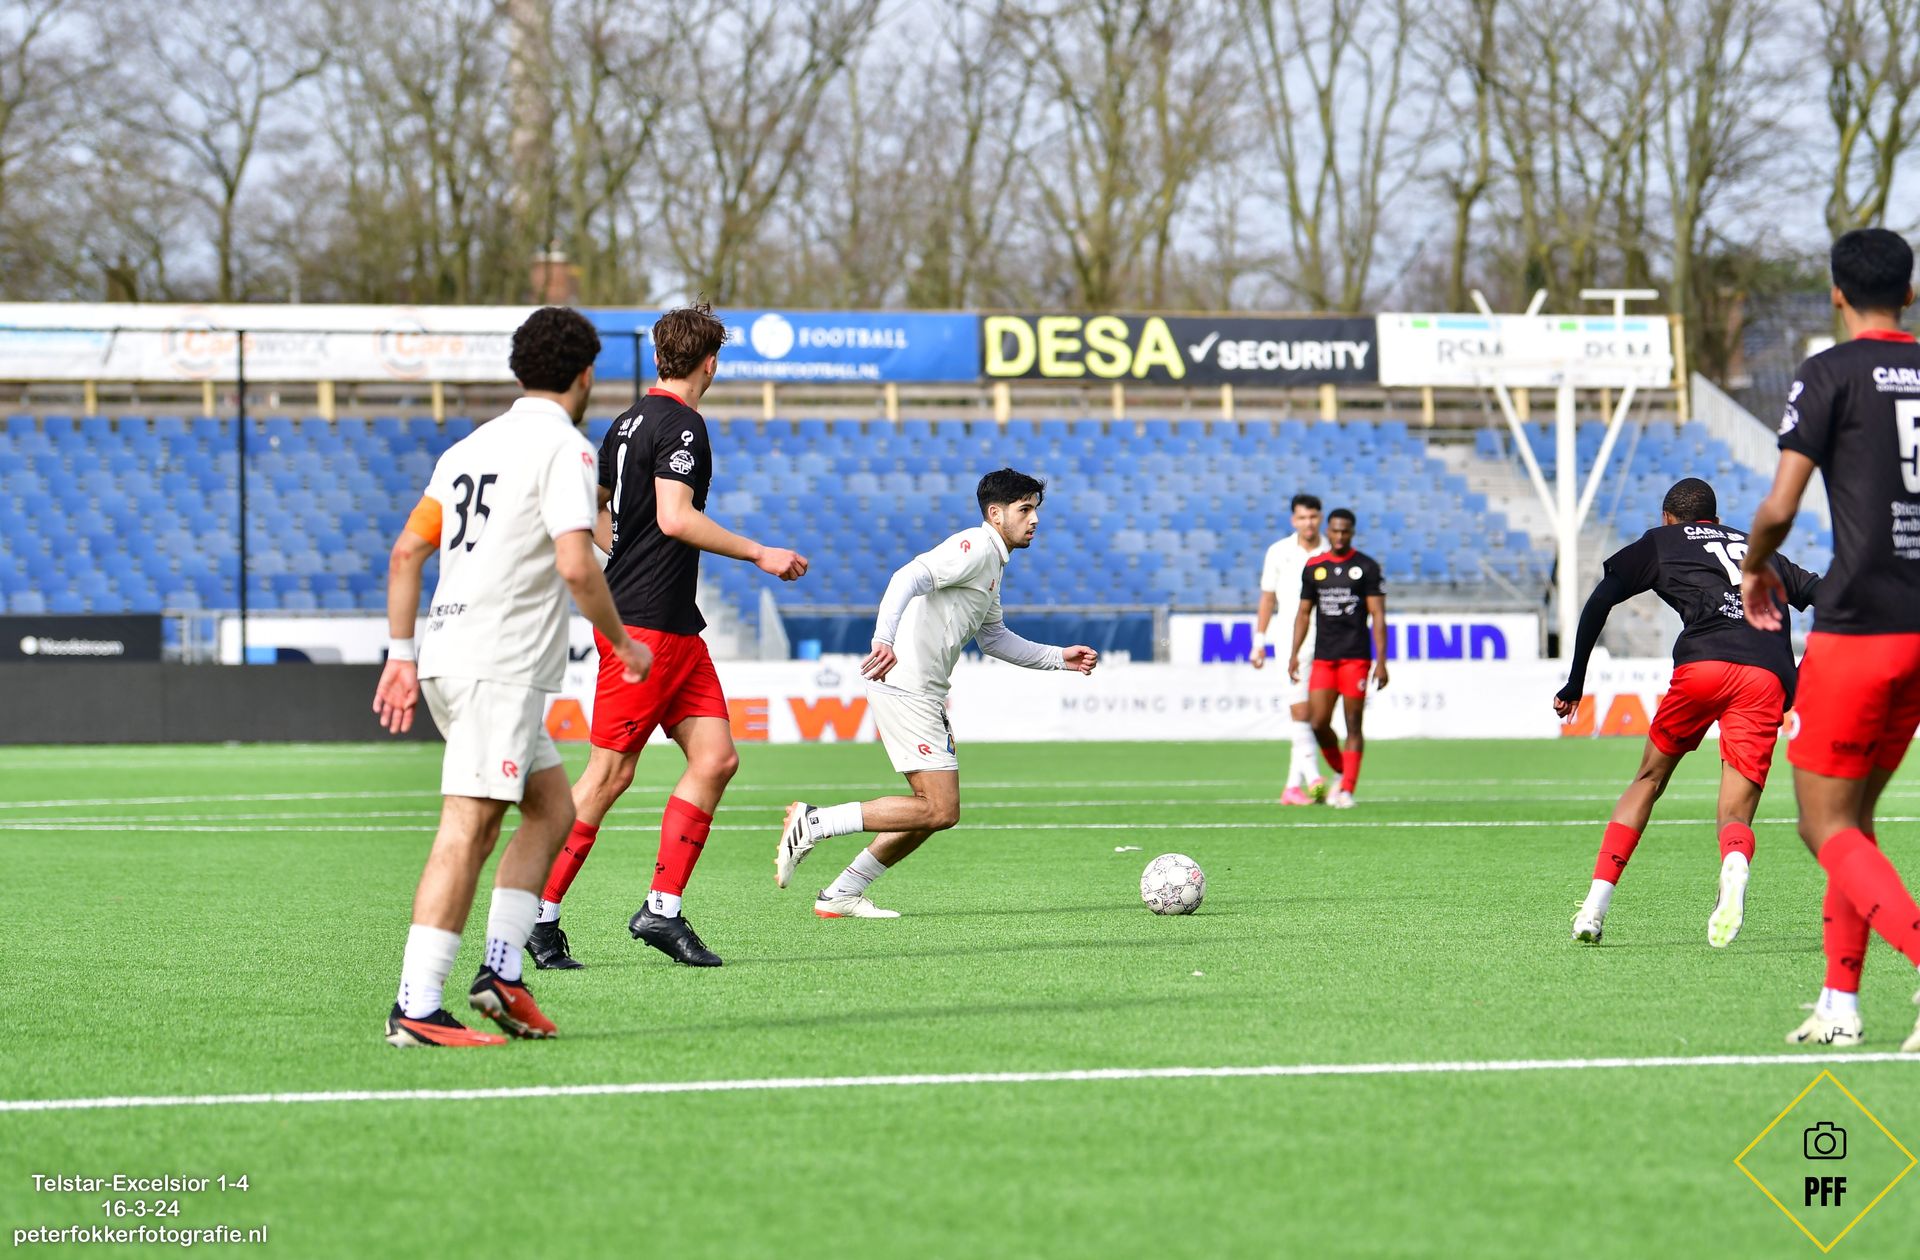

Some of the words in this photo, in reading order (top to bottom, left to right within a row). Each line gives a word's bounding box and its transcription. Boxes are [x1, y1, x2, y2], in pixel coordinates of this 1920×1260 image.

[799, 326, 908, 348] FOOTBALL
[985, 316, 1185, 378] DESA
[1218, 341, 1369, 370] SECURITY
[1895, 399, 1920, 493] 5
[449, 473, 498, 552] 35
[1060, 696, 1168, 714] MOVING
[1181, 696, 1282, 714] PEOPLE
